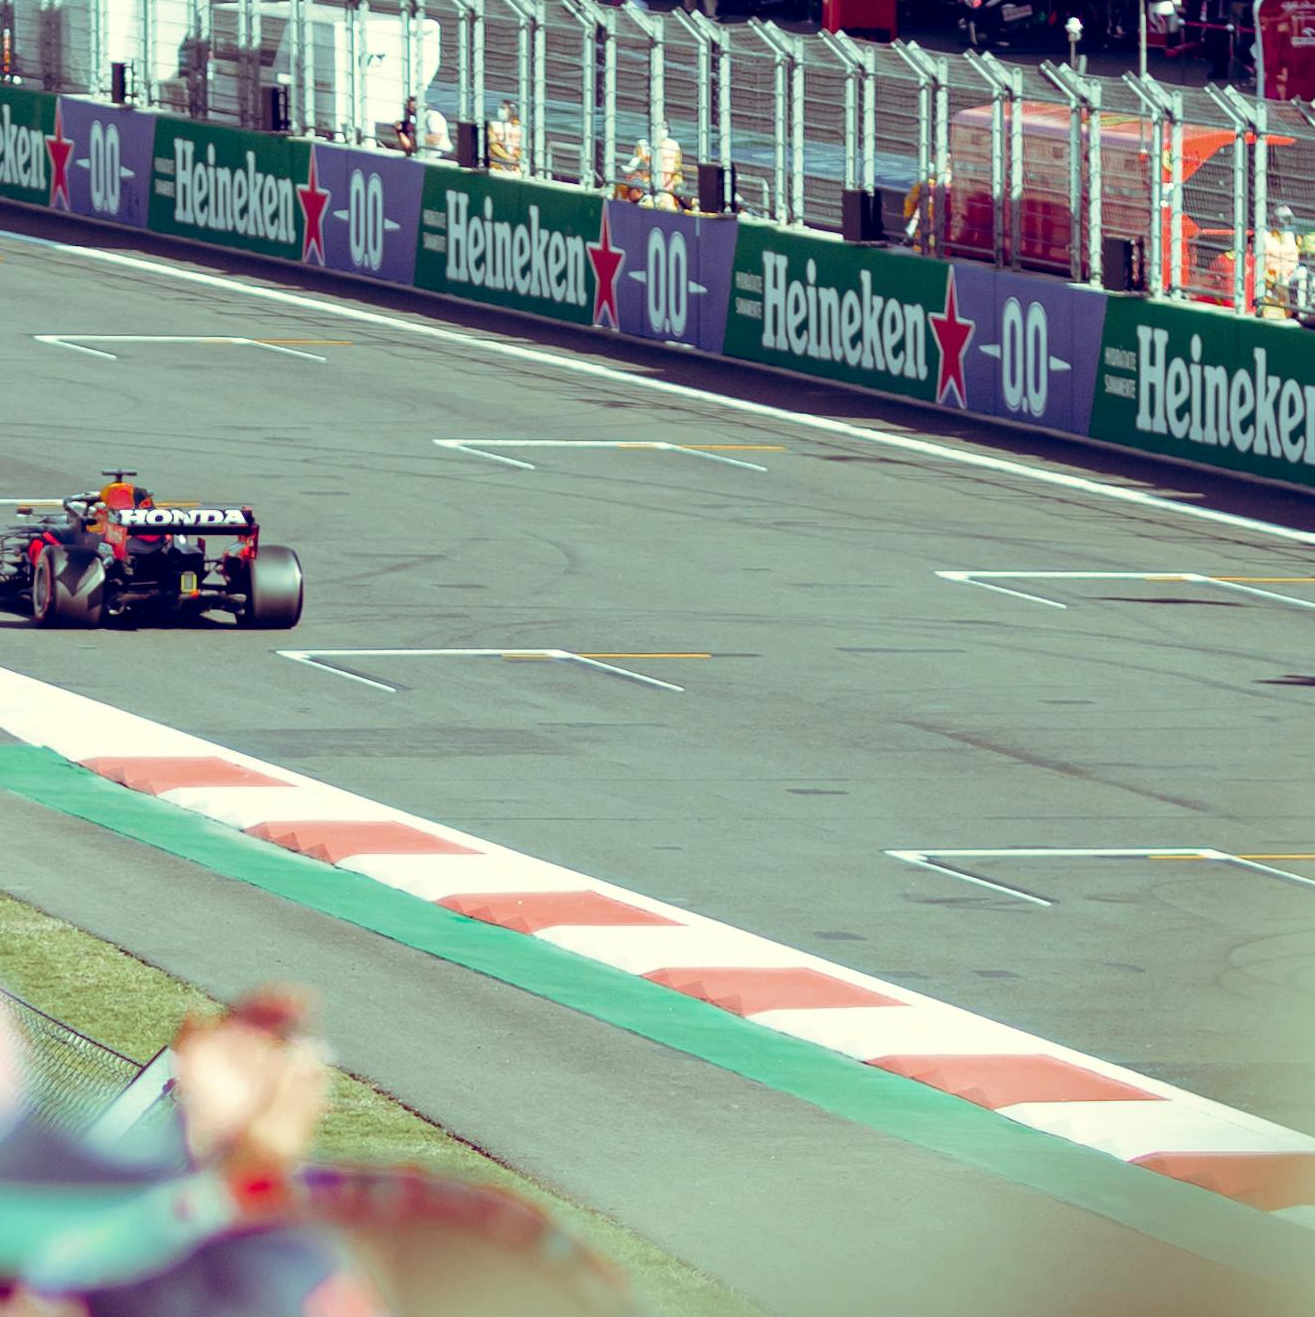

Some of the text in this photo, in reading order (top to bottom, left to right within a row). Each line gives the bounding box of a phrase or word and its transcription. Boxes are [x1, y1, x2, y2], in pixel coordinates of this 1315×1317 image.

[173, 137, 297, 245] Heineken
[349, 168, 384, 271] 0.0
[445, 189, 687, 337] Heineken 0.0
[761, 249, 1048, 418] Heineken 0.0
[118, 509, 247, 525] HONDA
